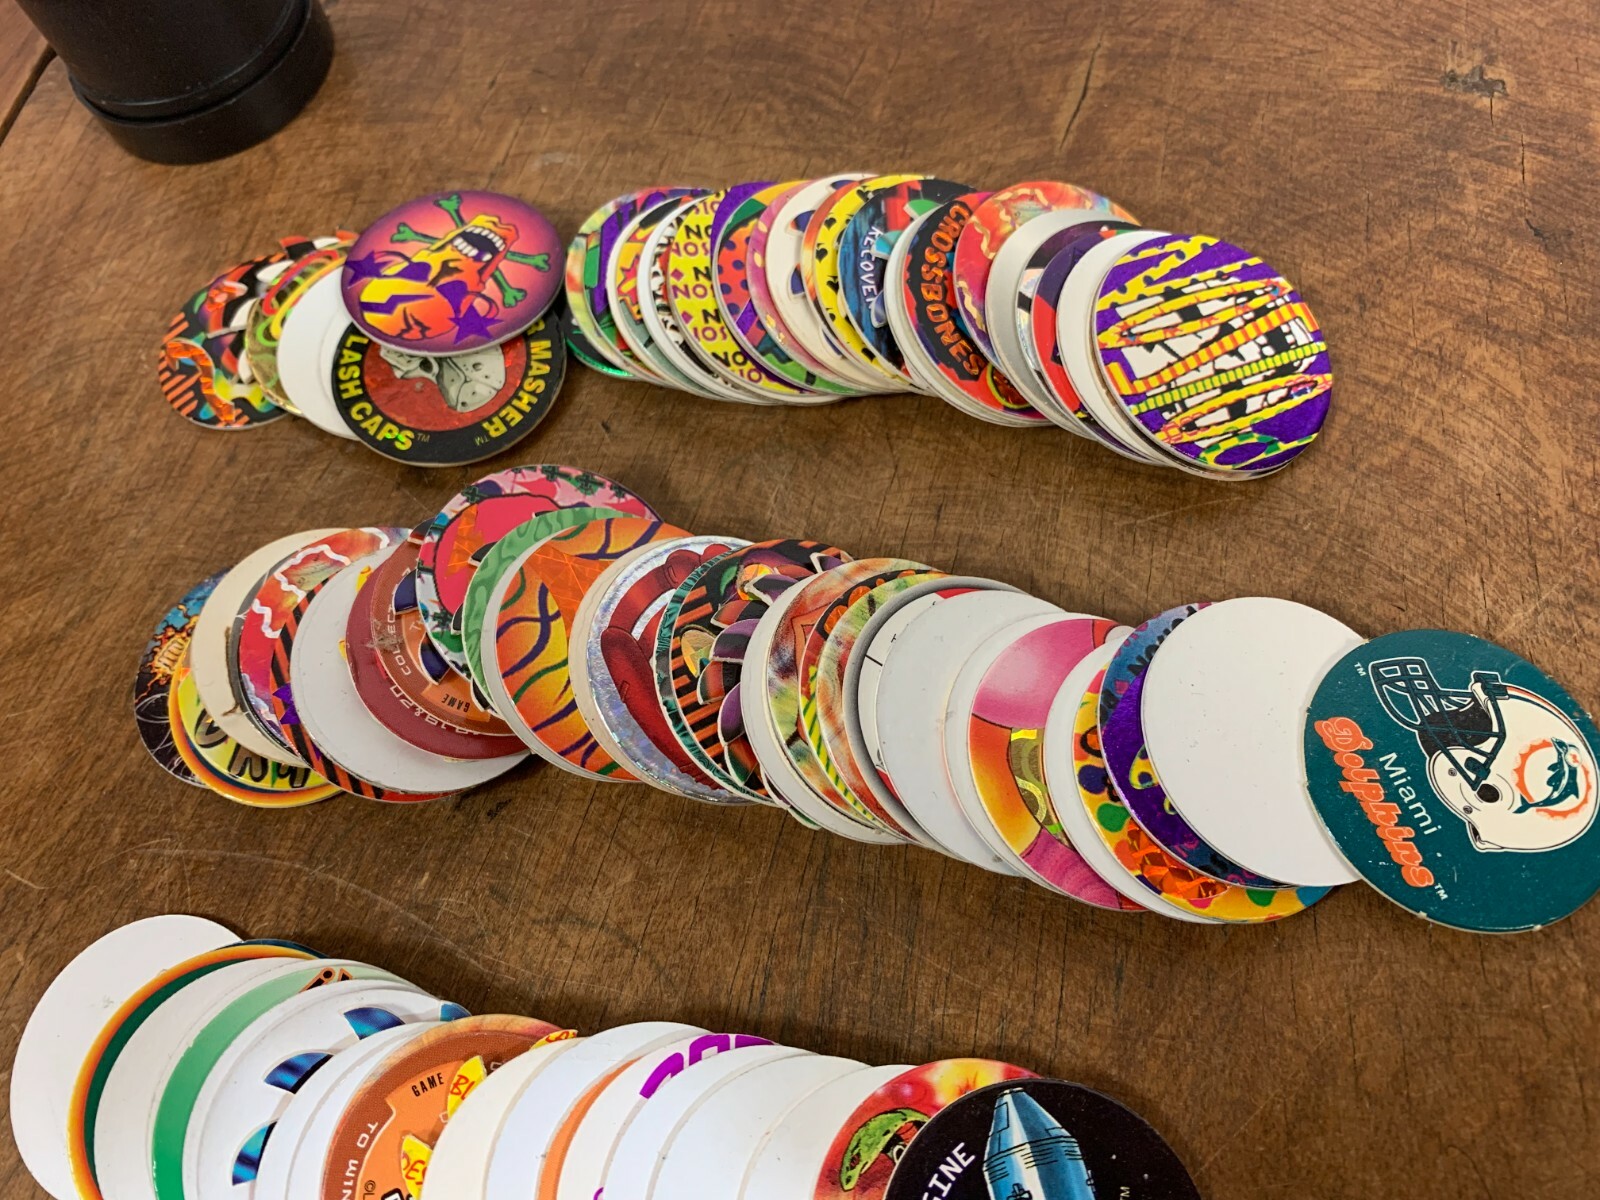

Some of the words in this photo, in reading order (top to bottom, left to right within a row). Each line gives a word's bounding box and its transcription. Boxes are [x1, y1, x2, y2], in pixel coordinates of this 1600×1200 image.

[920, 204, 986, 377] CROSSBONES
[338, 335, 369, 399] LASH
[482, 340, 552, 438] MASHER
[350, 401, 415, 451] CAPS
[441, 693, 471, 713] GAME
[1314, 717, 1435, 888] Dolphins
[1379, 752, 1442, 835] Miami
[411, 1072, 444, 1097] GAME
[356, 1121, 379, 1148] TO
